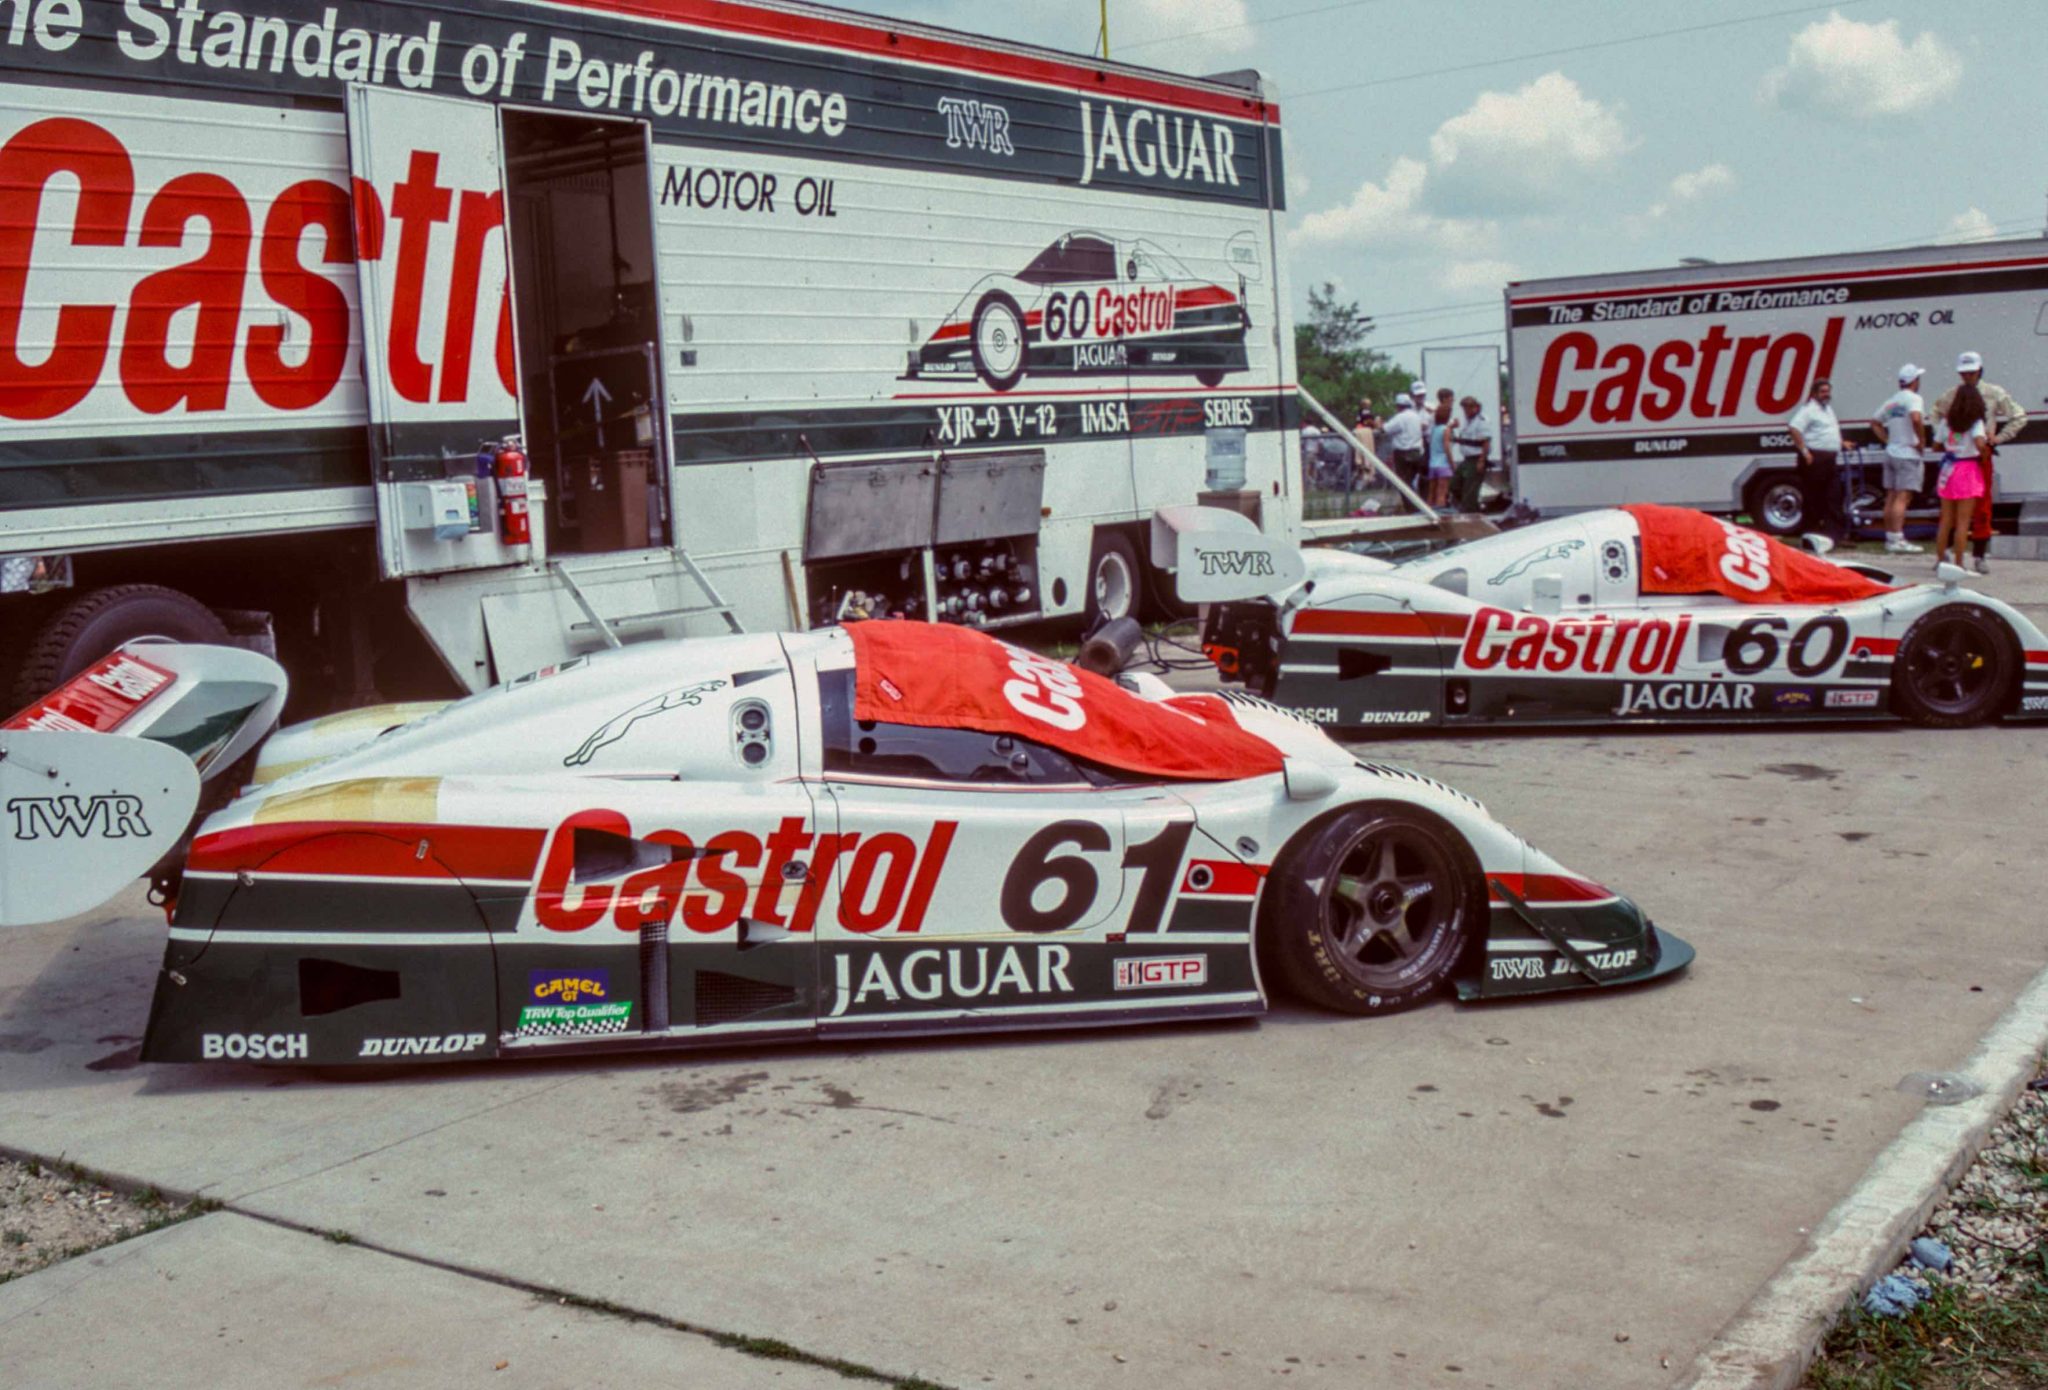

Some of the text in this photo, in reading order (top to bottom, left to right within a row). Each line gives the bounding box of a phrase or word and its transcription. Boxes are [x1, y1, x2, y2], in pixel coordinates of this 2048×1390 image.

[118, 0, 441, 88] Standard
[461, 32, 527, 96] of
[542, 36, 847, 136] Performance
[938, 97, 1014, 155] TWR
[1080, 101, 1239, 185] JAGUAR
[661, 166, 837, 216] MOTOR OIL
[0, 116, 517, 421] Castr
[1045, 285, 1175, 341] 60 Castrol
[1549, 287, 1850, 323] The Standard of Performance
[1855, 310, 1955, 330] MOTOR OIL
[1073, 344, 1128, 371] JAGUAR
[1534, 316, 1845, 427] Castrol
[936, 406, 1000, 446] XJR-9
[1007, 404, 1057, 437] V-12
[1080, 402, 1130, 433] IMSA
[1204, 398, 1253, 427] SERIES
[1635, 440, 1688, 452] DUNLOP
[1760, 436, 1794, 448] BOSC
[1200, 551, 1275, 576] TWR
[1463, 607, 1693, 675] Castrol
[1723, 615, 1850, 677] 60
[1361, 711, 1431, 723] DUNLOP
[1617, 684, 1755, 714] JAGUAR
[7, 795, 151, 839] TWR
[535, 809, 958, 934] Castrol
[1001, 819, 1197, 934] 61
[830, 945, 1074, 1016] JAGUAR
[1144, 961, 1200, 981] GTP
[1490, 957, 1546, 980] TWR
[534, 978, 605, 998] CAMEL
[561, 991, 578, 1002] GT
[524, 1003, 627, 1020] TRW Top Qualifier
[203, 1034, 308, 1059] BOSCH
[359, 1034, 487, 1057] DUNLOP
